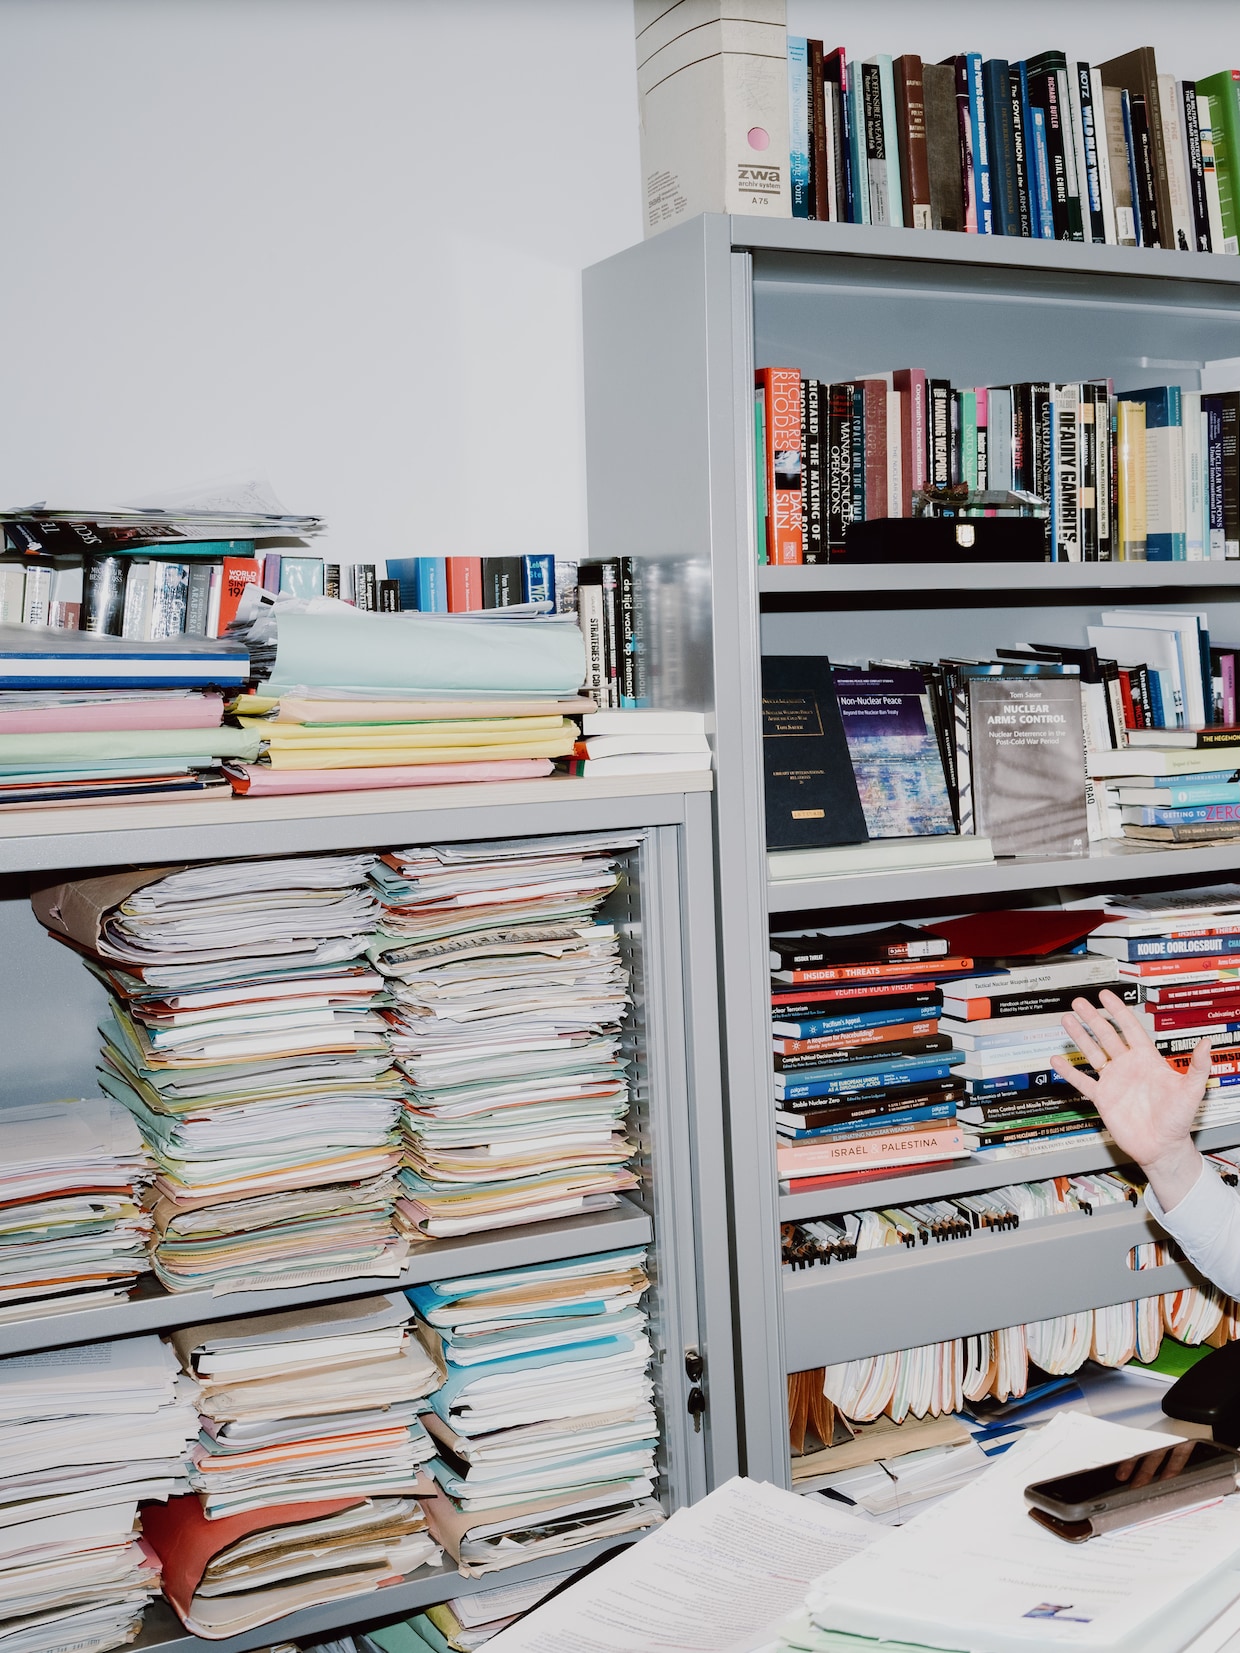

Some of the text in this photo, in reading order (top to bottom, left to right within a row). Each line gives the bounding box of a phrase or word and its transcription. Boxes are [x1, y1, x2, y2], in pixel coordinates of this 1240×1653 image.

[1080, 70, 1090, 99] KOTZ
[1048, 76, 1059, 129] RICHARD BUTLER
[1012, 99, 1027, 217] SOVIET UNION ARMS
[1082, 106, 1101, 212] WILD BLUE YONDER
[738, 169, 780, 182] zwa
[794, 177, 803, 204] Point
[1054, 155, 1066, 203] FATAL CHOICE
[774, 371, 790, 450] RHODES
[788, 372, 800, 451] RICHARD
[840, 421, 850, 474] MANAGING
[934, 400, 948, 482] MAKING WEAPONS
[808, 380, 821, 541] RICHARD THE MAKING OF
[831, 445, 841, 515] OPERATIONS
[1060, 412, 1078, 543] DEADLY GAMBITS
[1215, 442, 1224, 528] NUCLEAR WEAPONS
[776, 493, 790, 529] SUN
[790, 491, 802, 531] DARK
[590, 618, 600, 673] STRATEGIES OF
[622, 579, 636, 699] de tijd wacht op niemand
[841, 697, 902, 705] Non-Nuclear Peace
[1140, 670, 1150, 710] Unarmed
[987, 714, 1067, 724] ARMS CONTROL
[1004, 705, 1049, 714] NUCLEAR
[996, 738, 1025, 746] Post-Cold
[1014, 730, 1047, 738] Deterrence
[1085, 783, 1096, 805] IRAQ
[1163, 811, 1195, 819] GETTING
[1196, 810, 1207, 818] TO
[1138, 939, 1223, 956] KOUDE OORLOGSBUIT
[804, 968, 880, 980] INSIDER THREATS
[844, 1018, 861, 1027] Appeal
[1208, 1010, 1235, 1019] Cultivating
[782, 1054, 816, 1064] Complex Political
[792, 1101, 807, 1109] Stable
[827, 1098, 841, 1106] Zero
[831, 1140, 938, 1158] ISRAËL PALESTINA
